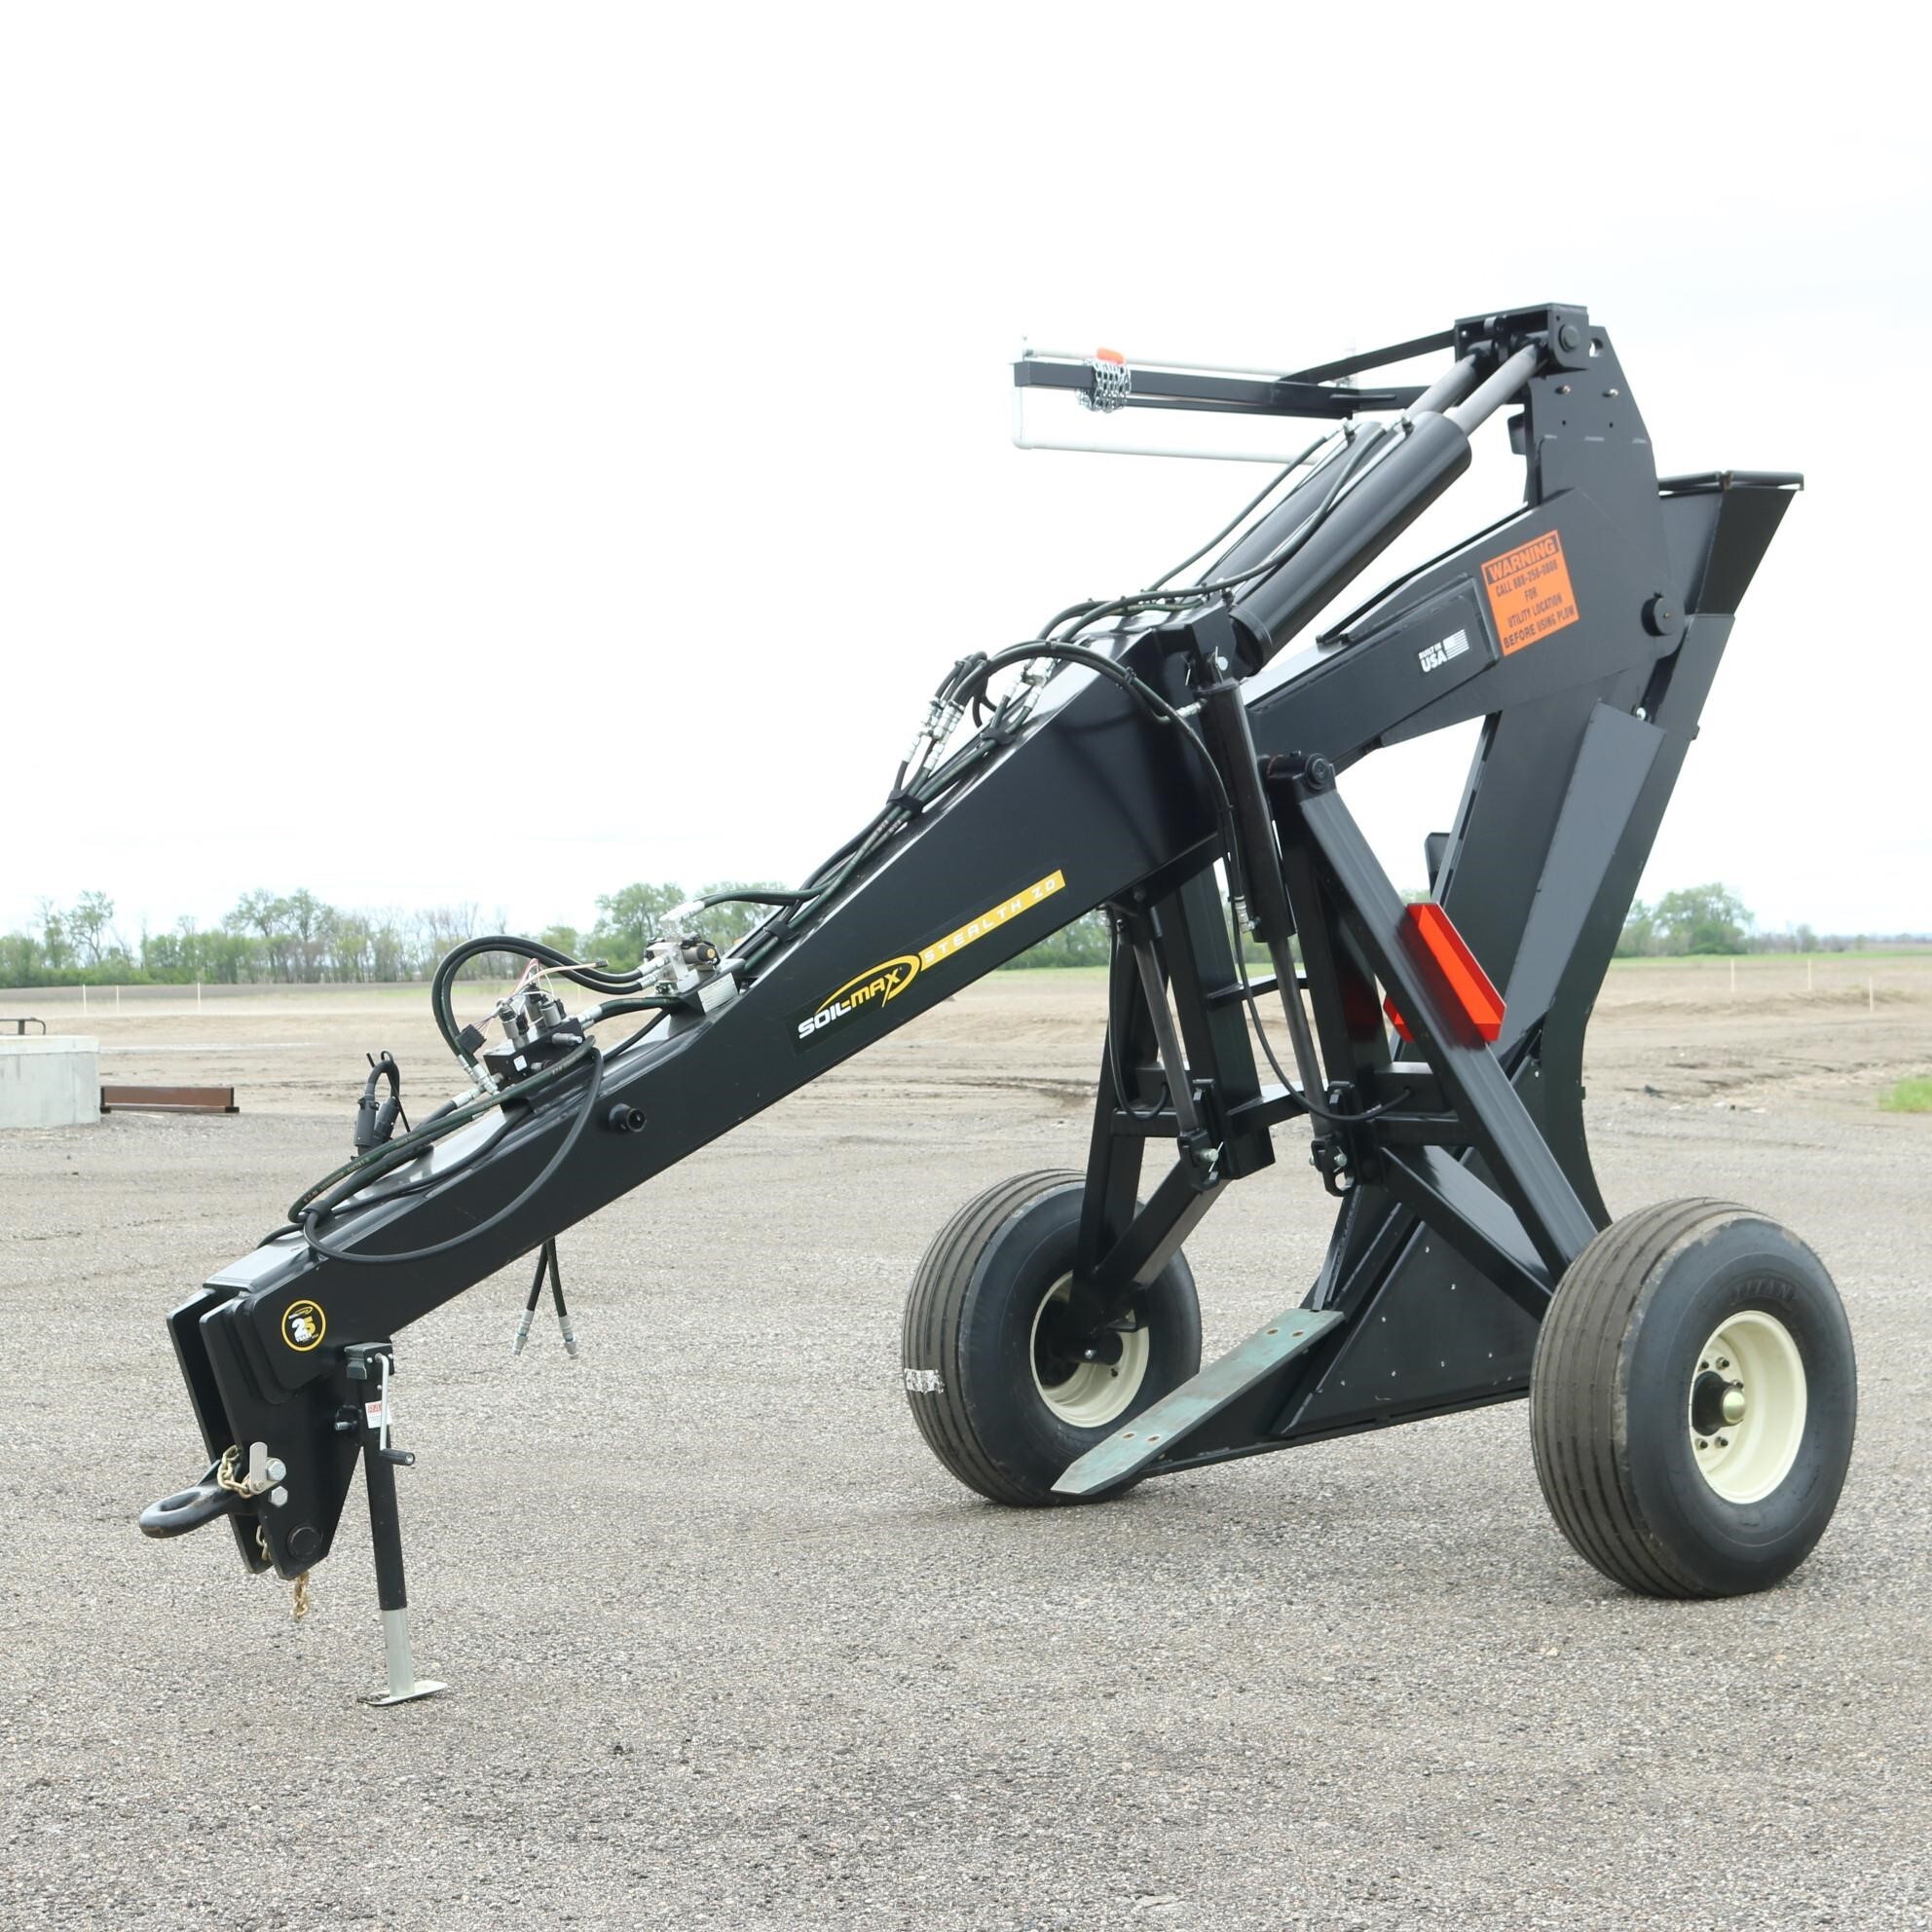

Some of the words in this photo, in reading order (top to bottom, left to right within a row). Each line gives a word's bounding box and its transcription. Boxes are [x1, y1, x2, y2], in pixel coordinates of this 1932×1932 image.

[1488, 537, 1556, 581] WARNING
[1495, 583, 1513, 597] CALL
[1524, 587, 1538, 602] FOR
[1504, 623, 1536, 649] BEFORE
[1537, 613, 1556, 632] USING
[1557, 605, 1576, 620] PLOW
[1507, 607, 1532, 628] UTILITY
[1533, 592, 1563, 616] LOCATION
[1421, 650, 1448, 673] USA
[923, 900, 1022, 963] STEALTH
[798, 968, 901, 1040] SOIL-MAX
[292, 1316, 316, 1340] 25
